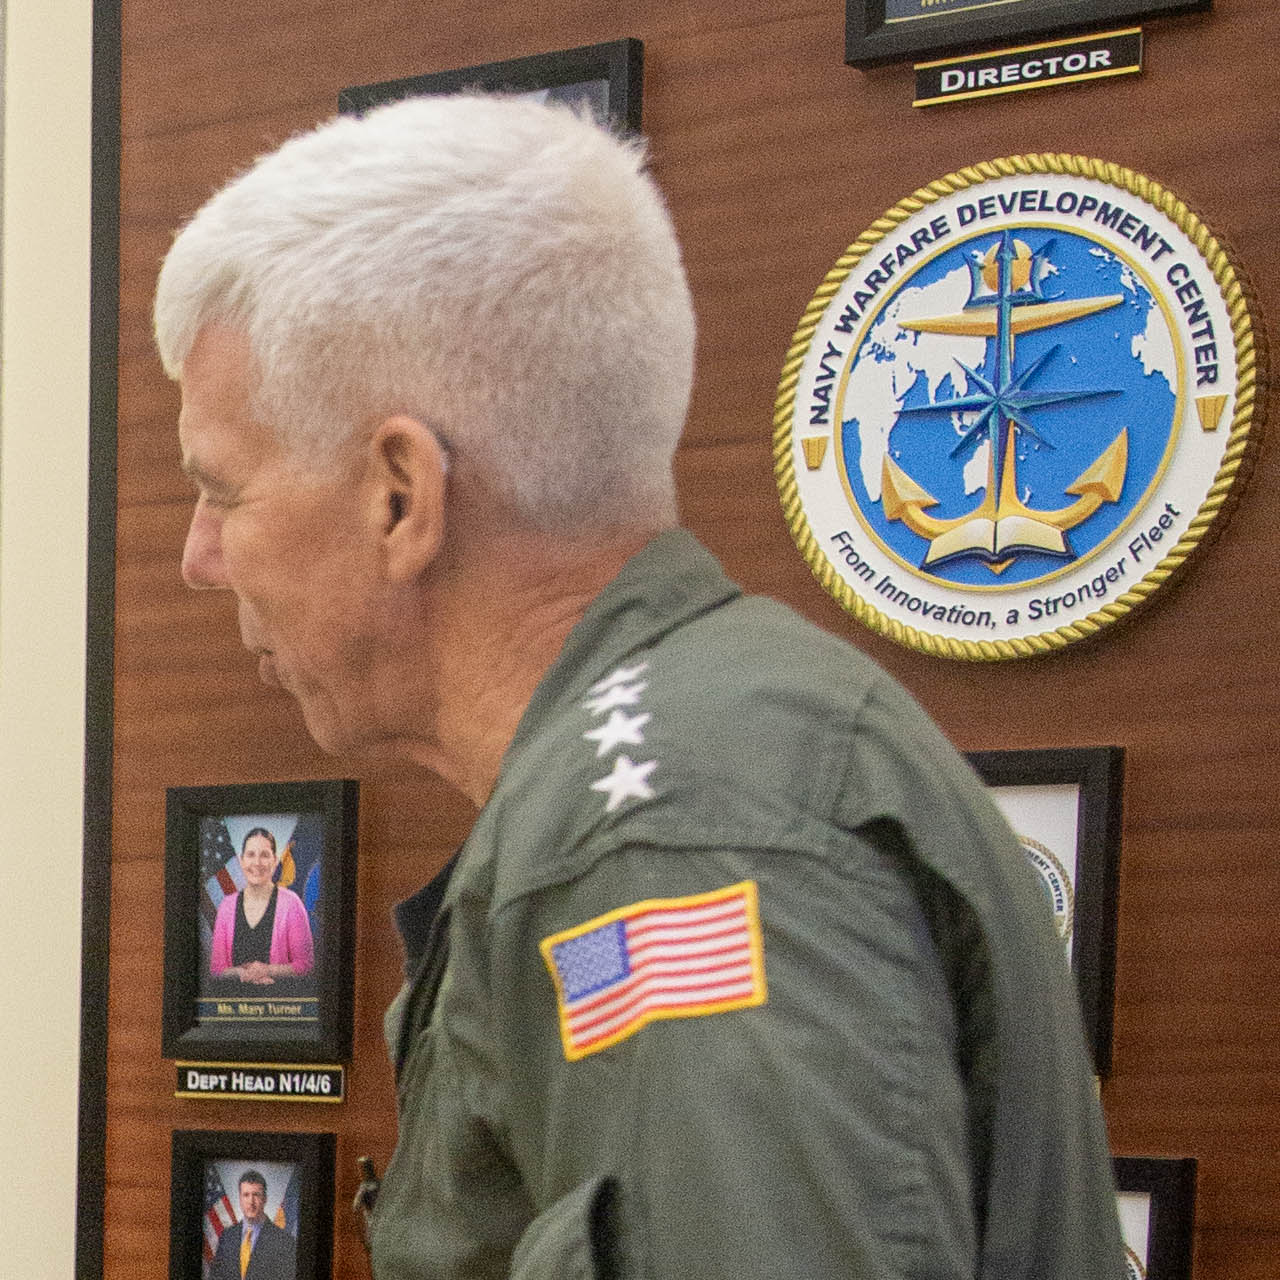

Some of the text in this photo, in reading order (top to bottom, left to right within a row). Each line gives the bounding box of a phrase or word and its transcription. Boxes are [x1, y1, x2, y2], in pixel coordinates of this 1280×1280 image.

[941, 49, 1112, 92] DIRECTOR
[809, 189, 1219, 425] NAVY WARFARE DEVELOPMENT CENTER
[830, 502, 1181, 630] From Innovation, a Stronger Fleet
[1047, 872, 1064, 912] CENTER
[238, 1003, 265, 1016] Mary
[187, 1071, 332, 1094] DEPT HEAD N1/4/6
